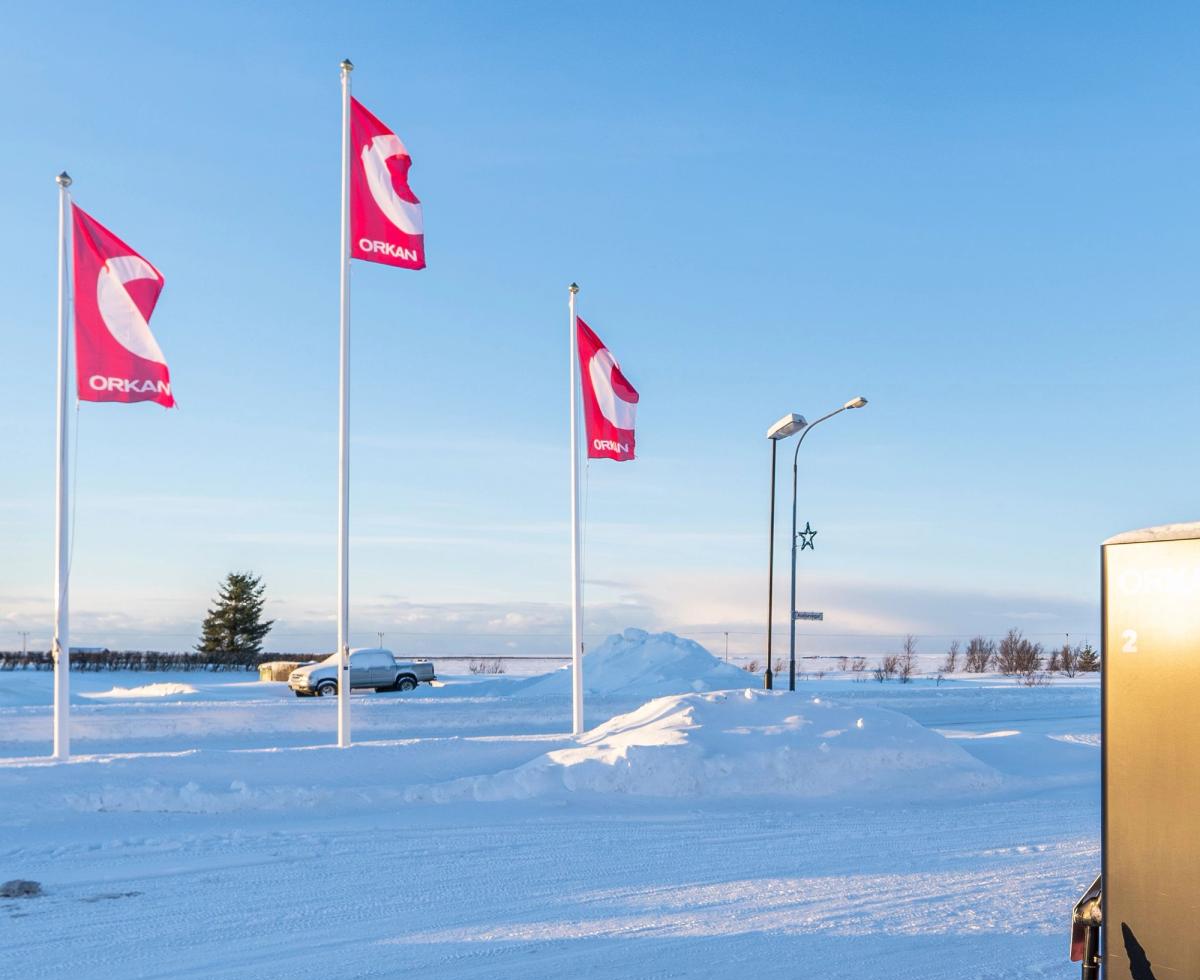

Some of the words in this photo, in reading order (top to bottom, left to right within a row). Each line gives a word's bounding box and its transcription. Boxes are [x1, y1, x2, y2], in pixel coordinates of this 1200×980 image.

[359, 238, 418, 262] ORKAN
[89, 375, 171, 396] ORKAN
[1121, 628, 1138, 653] 2
